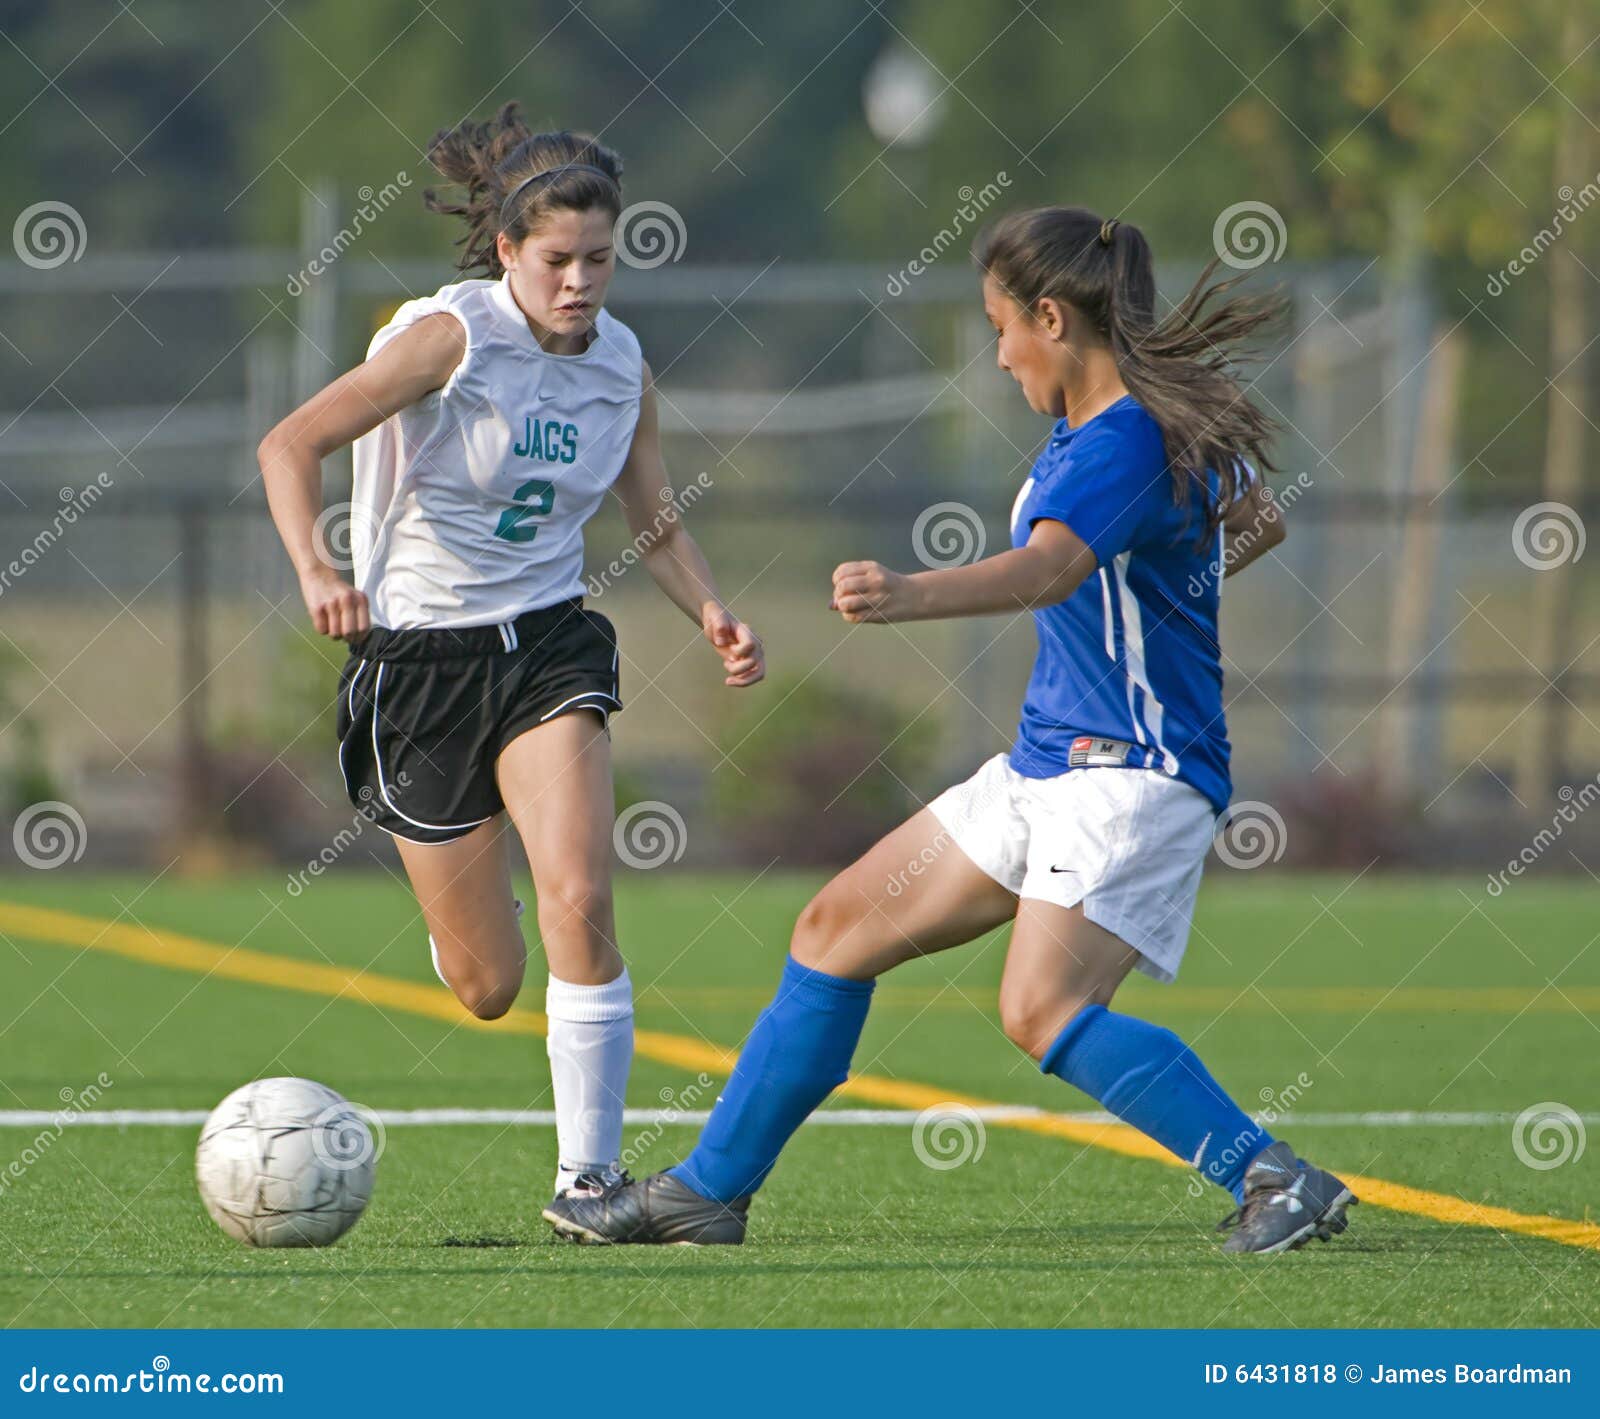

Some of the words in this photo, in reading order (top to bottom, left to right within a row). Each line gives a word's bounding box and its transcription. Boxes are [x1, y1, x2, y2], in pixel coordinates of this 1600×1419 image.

[514, 417, 578, 464] JAGS
[494, 479, 556, 542] 2
[1100, 743, 1113, 752] M
